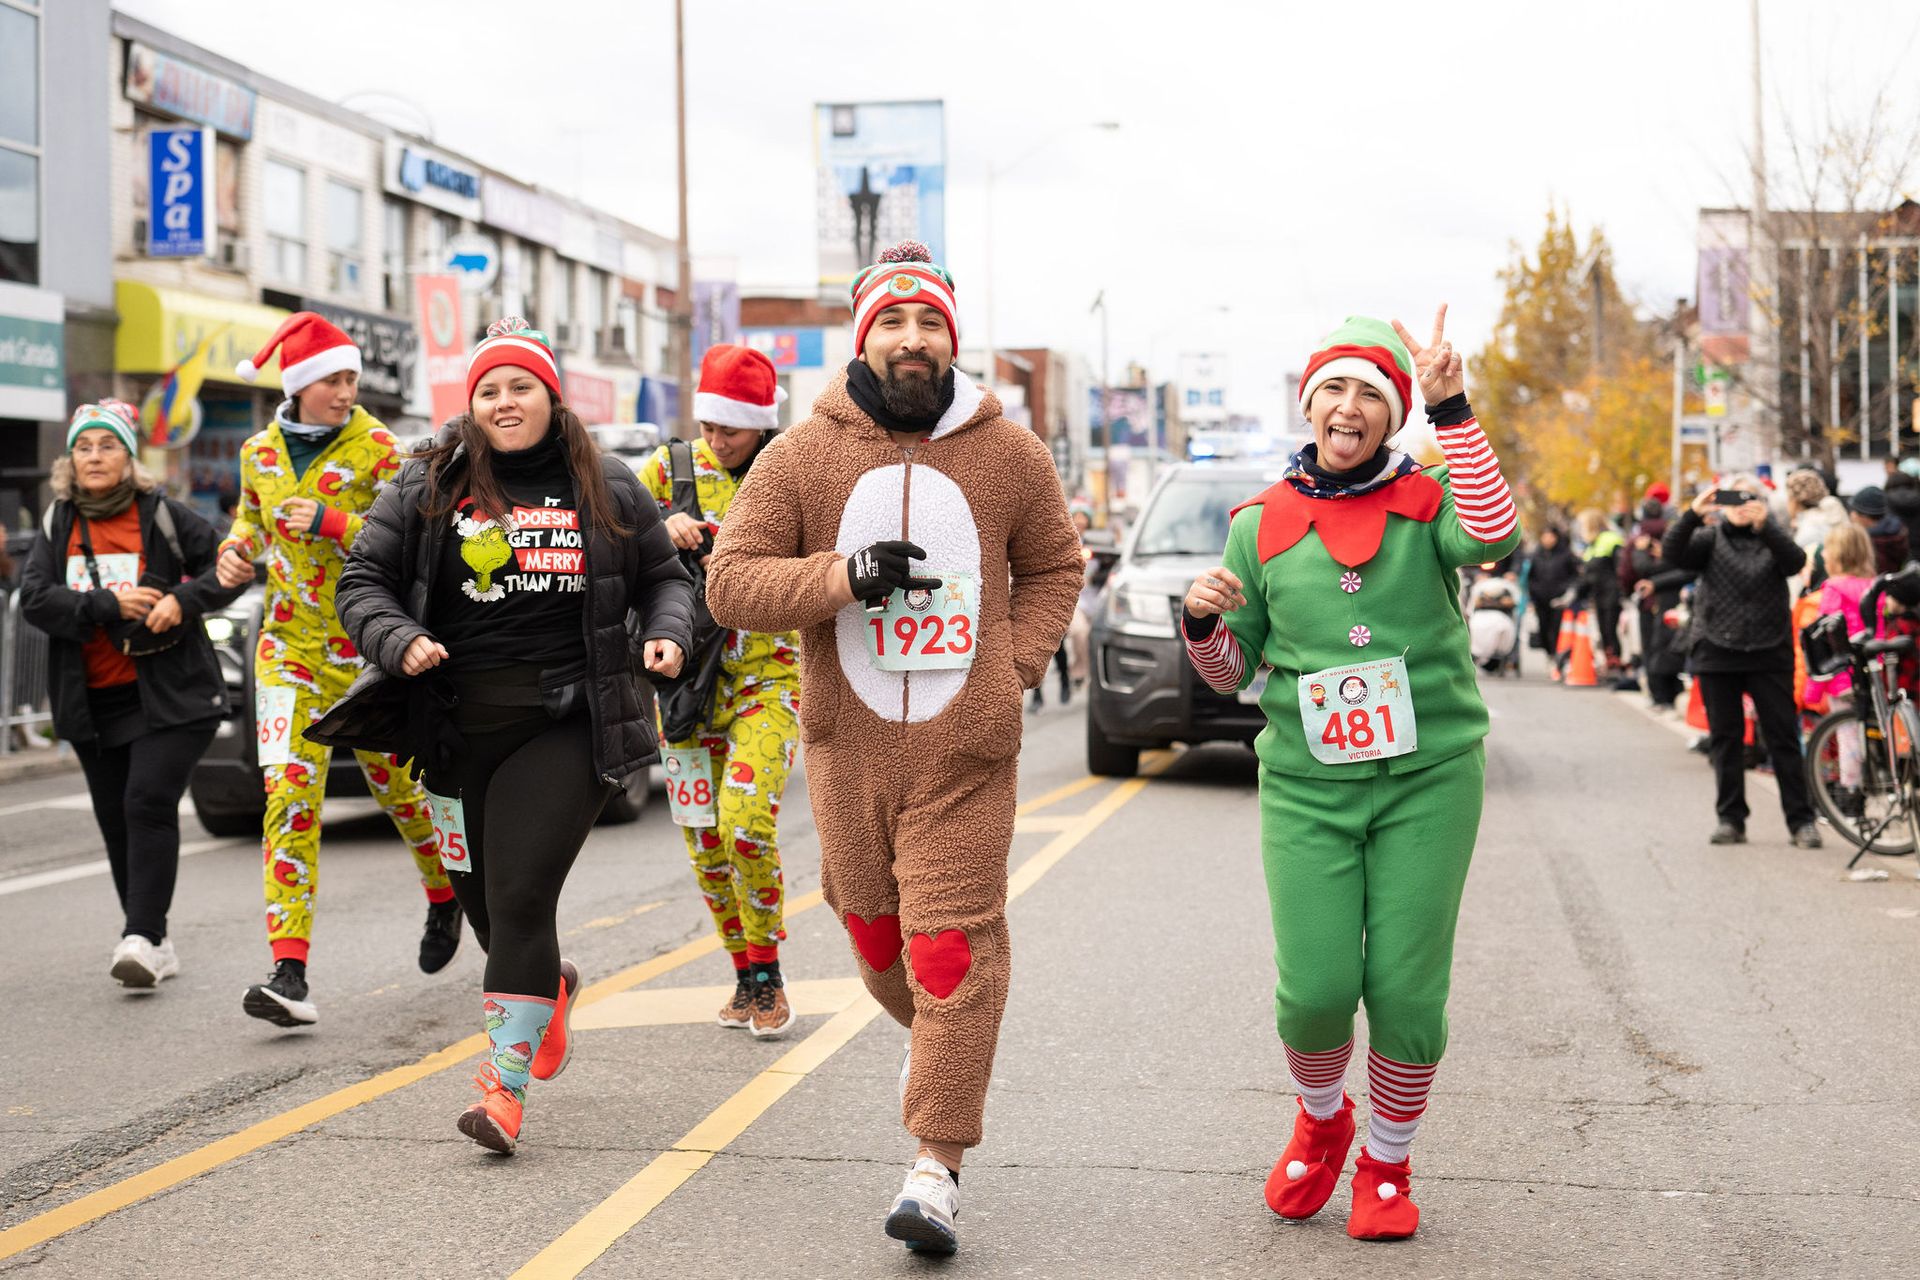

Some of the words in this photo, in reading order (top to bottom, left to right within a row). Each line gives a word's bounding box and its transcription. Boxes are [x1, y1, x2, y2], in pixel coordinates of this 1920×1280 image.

[517, 510, 577, 527] DOESN'
[507, 530, 544, 548] GET
[524, 550, 583, 571] MERRY
[504, 573, 552, 593] THAN
[869, 614, 973, 657] 1923
[1322, 704, 1395, 750] 481
[1347, 748, 1382, 760] VICTORIA
